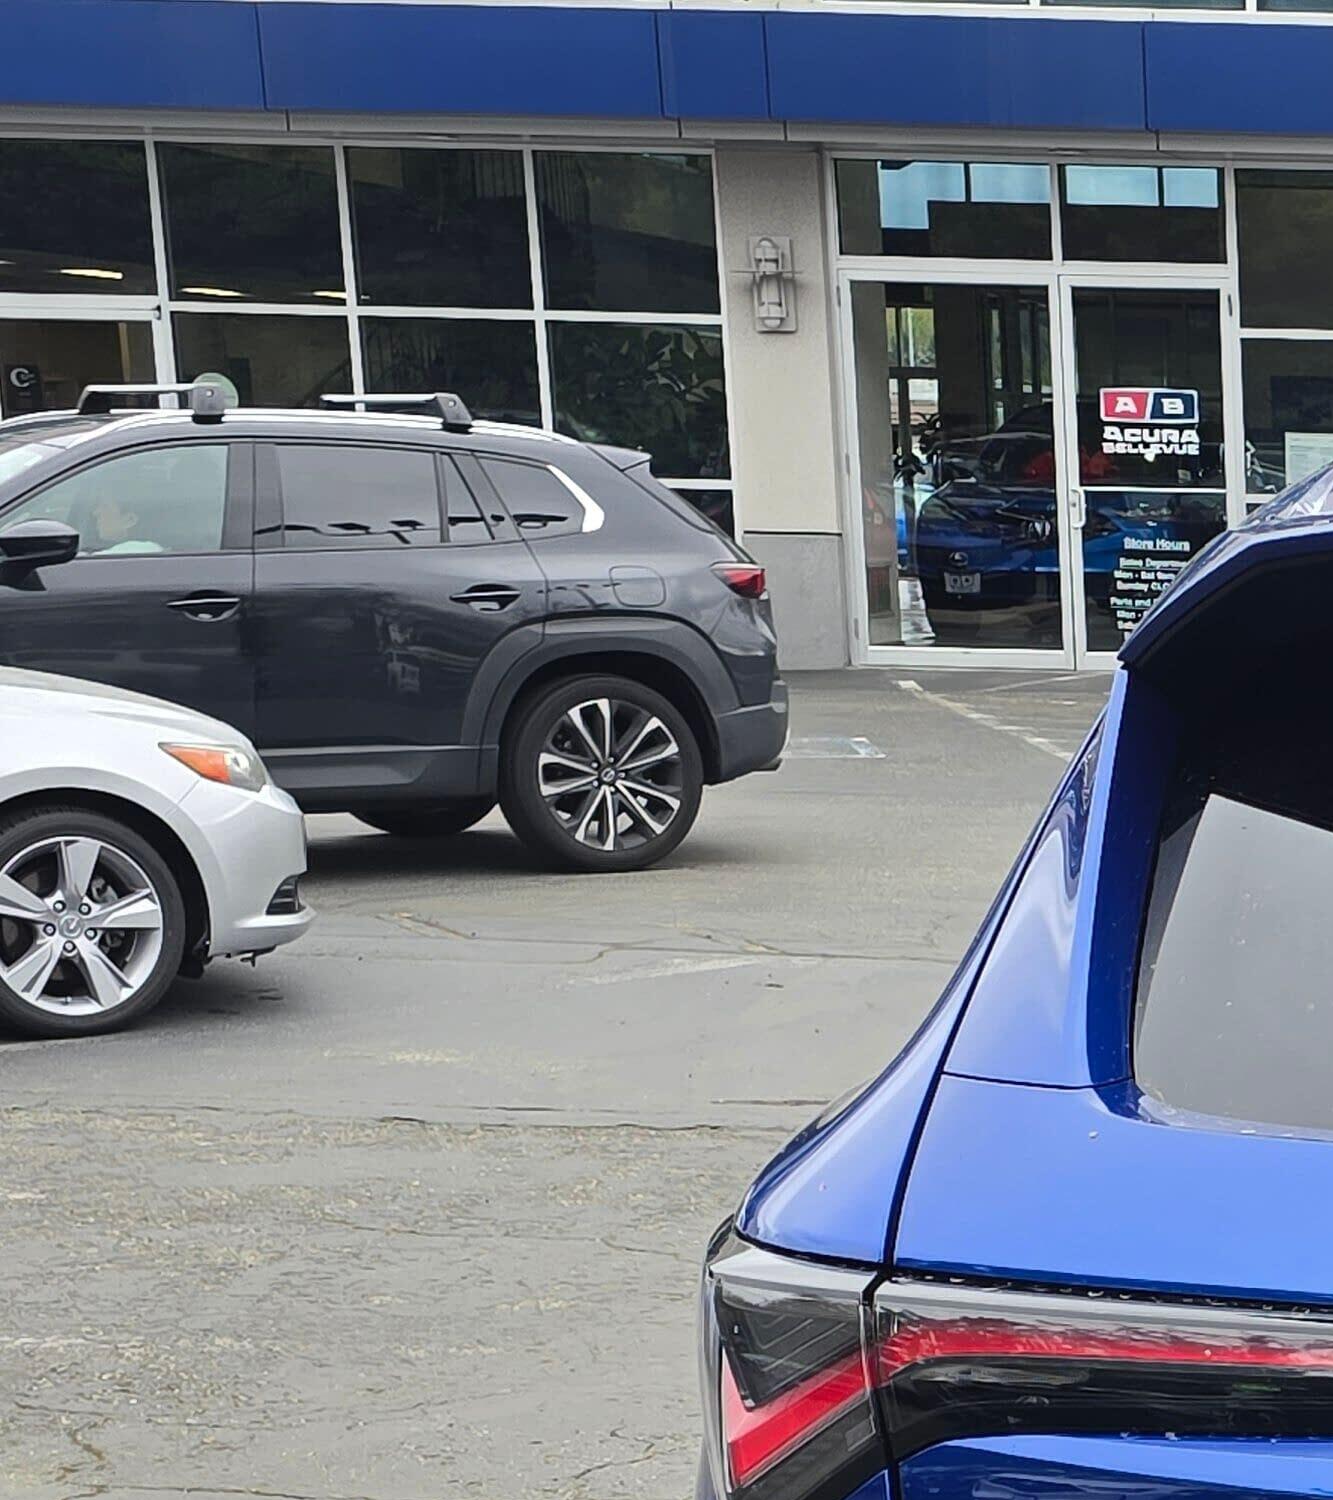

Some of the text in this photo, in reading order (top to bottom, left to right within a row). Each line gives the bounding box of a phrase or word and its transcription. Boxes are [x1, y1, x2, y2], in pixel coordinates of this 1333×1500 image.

[1114, 396, 1184, 414] A B
[1103, 426, 1200, 443] ACURA
[1102, 442, 1200, 455] BELLEVUE
